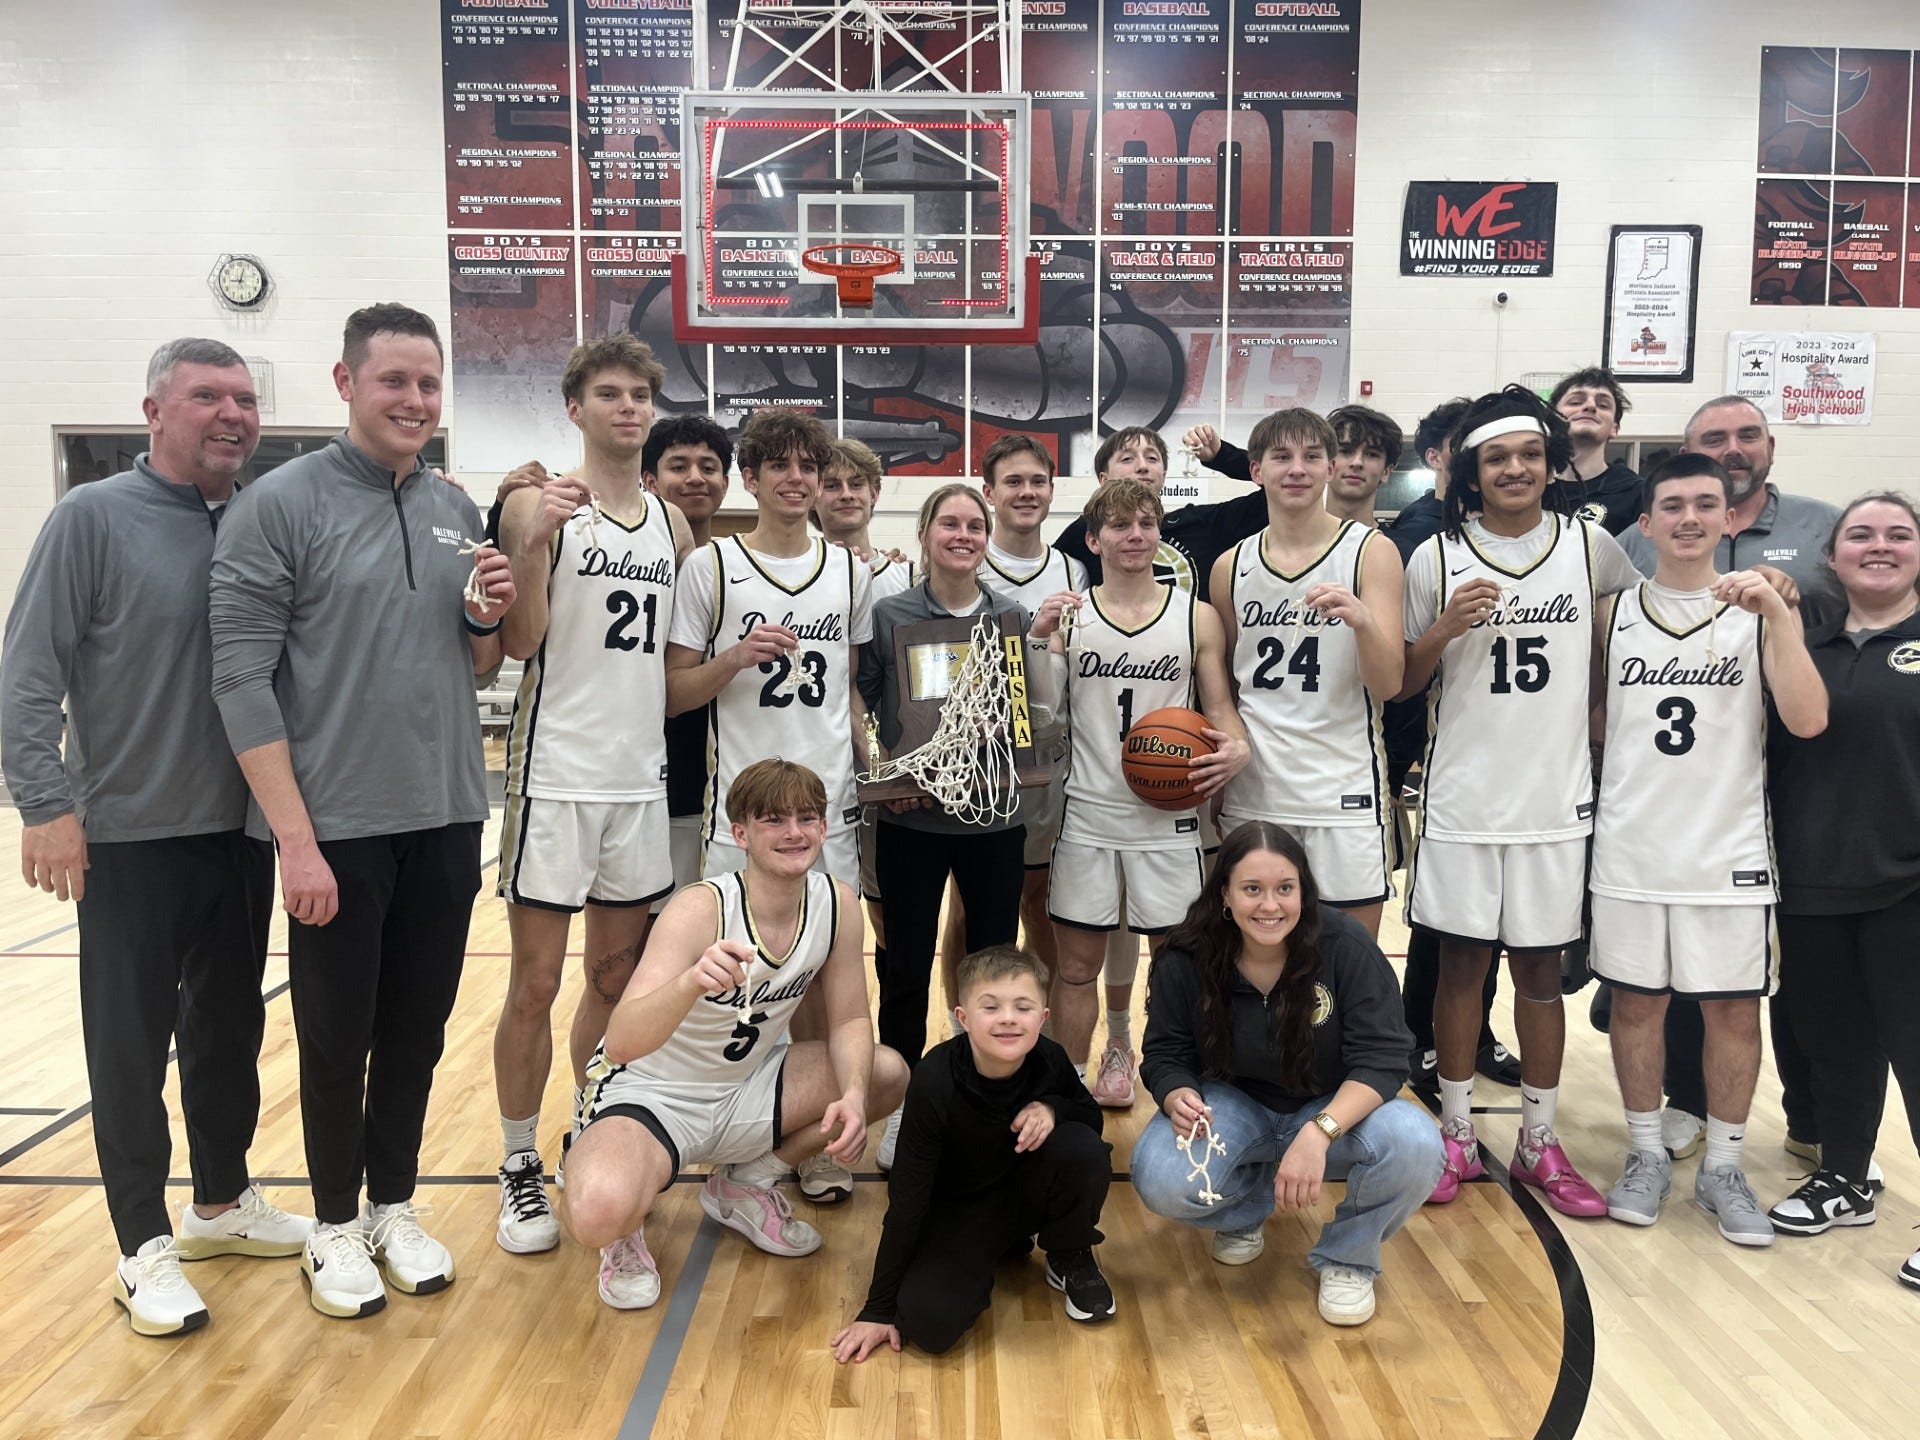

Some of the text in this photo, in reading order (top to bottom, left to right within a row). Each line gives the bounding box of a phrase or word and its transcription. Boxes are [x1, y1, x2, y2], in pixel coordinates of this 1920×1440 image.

[1022, 2, 1066, 15] ENNIS
[1123, 2, 1210, 16] BASEBALL
[1255, 2, 1340, 16] SOFTBALL
[451, 15, 559, 24] CONFERENCE CHAMPIONS
[585, 17, 692, 26] CONFERENCE CHAMPIONS
[548, 27, 558, 35] '17
[1037, 22, 1088, 31] CHAMPIONS
[1114, 23, 1219, 31] CONFERENCE CHAMPIONS
[1244, 24, 1350, 32] CONFERENCE CHAMPIONS
[457, 82, 558, 91] SECTIONAL CHAMPIONS
[590, 84, 638, 92] SECTIONAL
[1243, 91, 1342, 99] SECTIONAL CHAMPIONS
[461, 148, 557, 157] REGIONAL CHAMPIONS
[594, 151, 637, 159] REGIONAL
[1118, 156, 1211, 164] REGIONAL CHAMPIONS
[1112, 166, 1123, 174] '03
[460, 195, 562, 204] SEMI-STATE CHAMPIONS
[592, 198, 681, 206] SEMI-STATE CHAMPIO
[1114, 202, 1213, 210] SEMI-STATE CHAMPIONS
[1436, 183, 1527, 237] WE
[1768, 221, 1815, 229] FOOTBALL
[1843, 223, 1890, 231] BASEBALL
[483, 236, 541, 246] BOYS
[611, 238, 677, 247] GIRLS
[1773, 240, 1807, 249] STATE
[1135, 242, 1191, 251] BOYS
[1260, 243, 1324, 252] GIRLS
[1408, 239, 1547, 260] WINNING EDGE
[1849, 242, 1883, 251] STATE
[455, 246, 570, 261] CROSS COUNTRY
[587, 248, 682, 262] CROSS COUN
[1758, 249, 1823, 259] RUNNER-UP
[1834, 251, 1897, 261] RUNNER-UP
[1111, 252, 1216, 267] TRACK & FIELD
[1239, 253, 1344, 267] TRACK & FIELD
[1414, 264, 1540, 273] #FIND YOUR EDGE
[1778, 261, 1802, 269] 1990
[1852, 263, 1878, 271] 2003
[460, 267, 566, 275] CONFERENCE CHAMPIONS
[591, 268, 645, 276] CONFERENCE
[722, 269, 774, 277] CONFERENCE
[1110, 272, 1162, 280] CONFERENCE
[1239, 273, 1290, 281] CONFERENCE
[1241, 338, 1338, 346] SECTIONAL CHAMPIONS
[1796, 341, 1856, 350] 2023 2024
[1741, 349, 1773, 358] LIME CITY
[1781, 353, 1869, 365] Hospitality Award
[1782, 385, 1865, 400] Southwood
[730, 398, 771, 406] REGIONAL
[1786, 403, 1860, 416] High School
[577, 547, 672, 588] Daleville
[1470, 594, 1579, 628] aleville
[605, 590, 657, 654] 21
[738, 611, 843, 641] Dleville
[1079, 652, 1181, 682] Daleville
[1253, 637, 1321, 692] 24
[1490, 635, 1551, 694] 15
[1619, 656, 1744, 686] Daleville
[758, 651, 828, 708] 23
[1117, 688, 1134, 742] 1
[1654, 696, 1697, 756] 3
[1128, 736, 1192, 759] Wilson
[1128, 773, 1190, 788] EVOLUTION
[723, 1011, 769, 1062] 5
